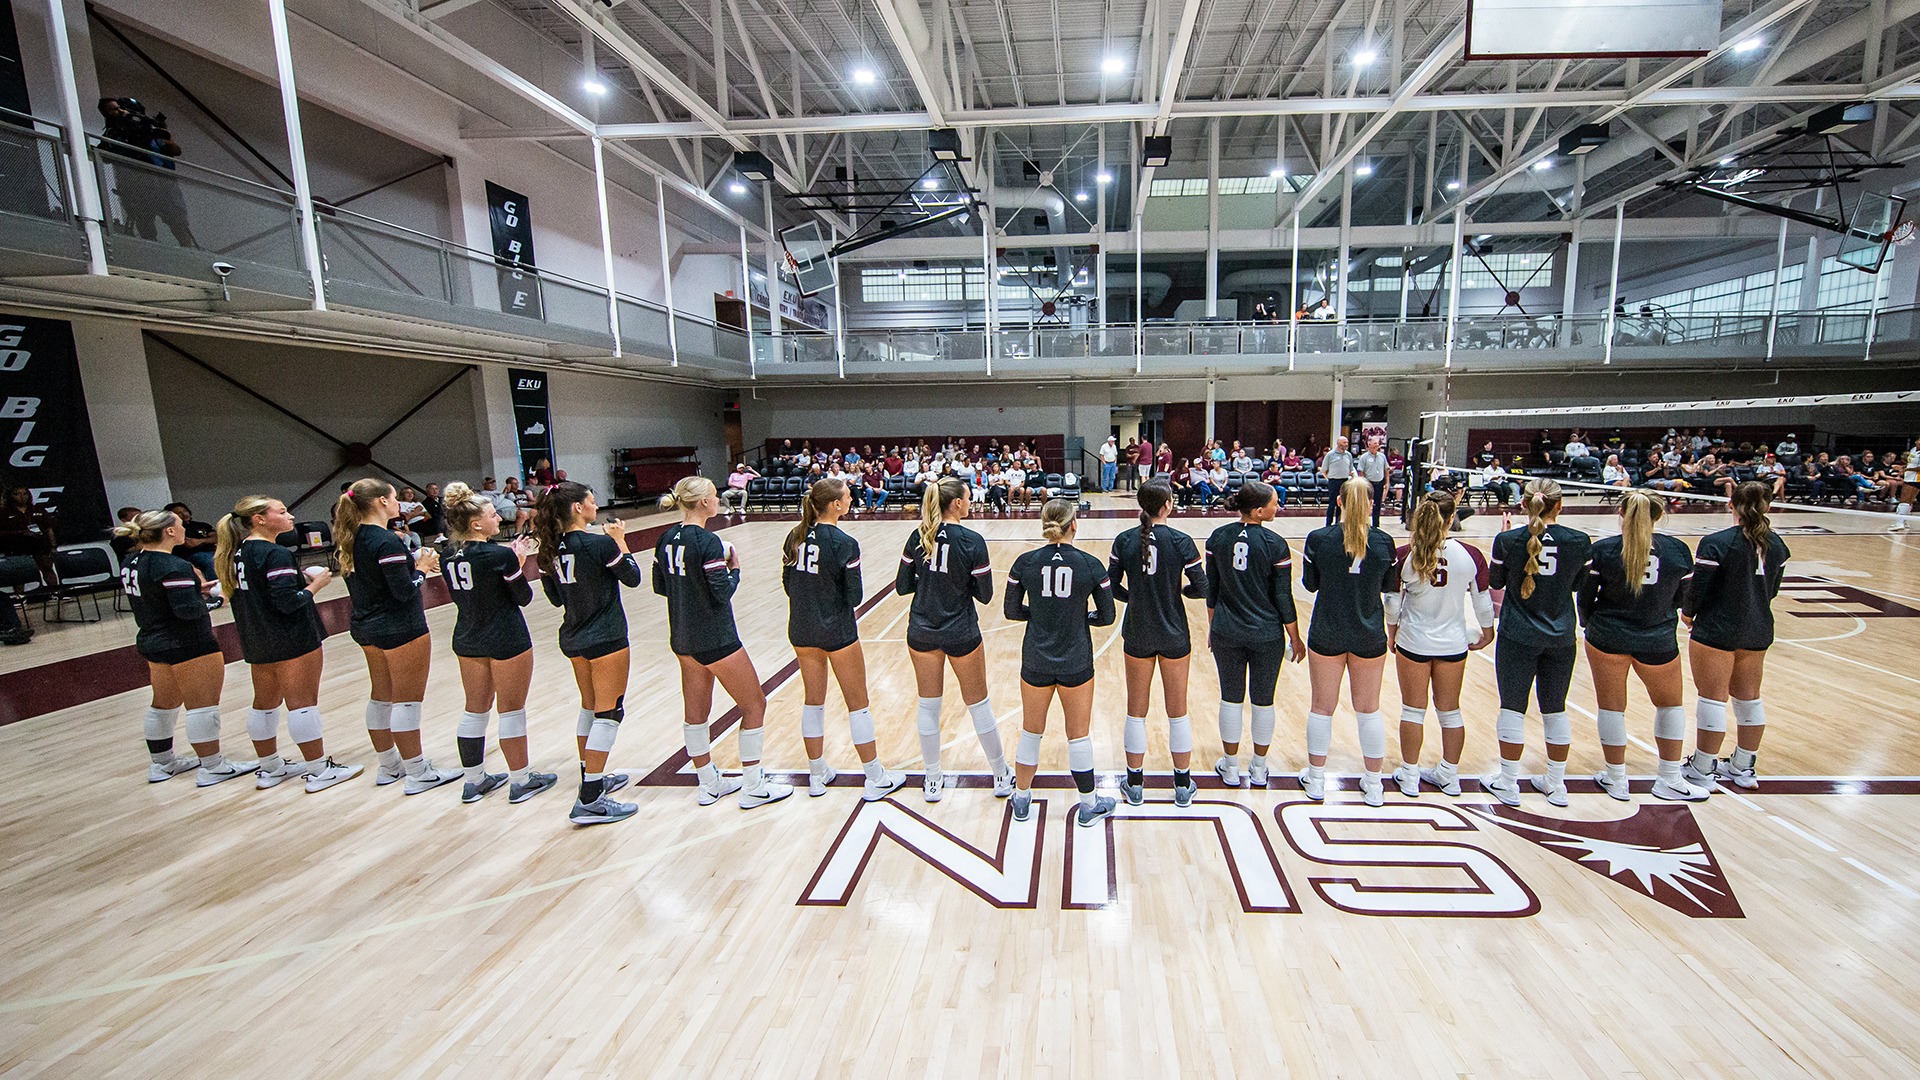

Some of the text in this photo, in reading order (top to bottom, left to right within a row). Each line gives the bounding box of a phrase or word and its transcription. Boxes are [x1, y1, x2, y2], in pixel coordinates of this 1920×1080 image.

[517, 379, 541, 390] EKU
[1851, 393, 1873, 401] EKU
[0, 397, 49, 467] BIG
[665, 544, 686, 576] 14
[796, 542, 820, 575] 12
[929, 542, 950, 574] 11
[1232, 541, 1249, 571] 8
[1537, 546, 1558, 576] 5
[120, 567, 141, 597] 23
[446, 561, 474, 591] 19
[1041, 565, 1073, 598] 10
[1430, 557, 1448, 588] 6
